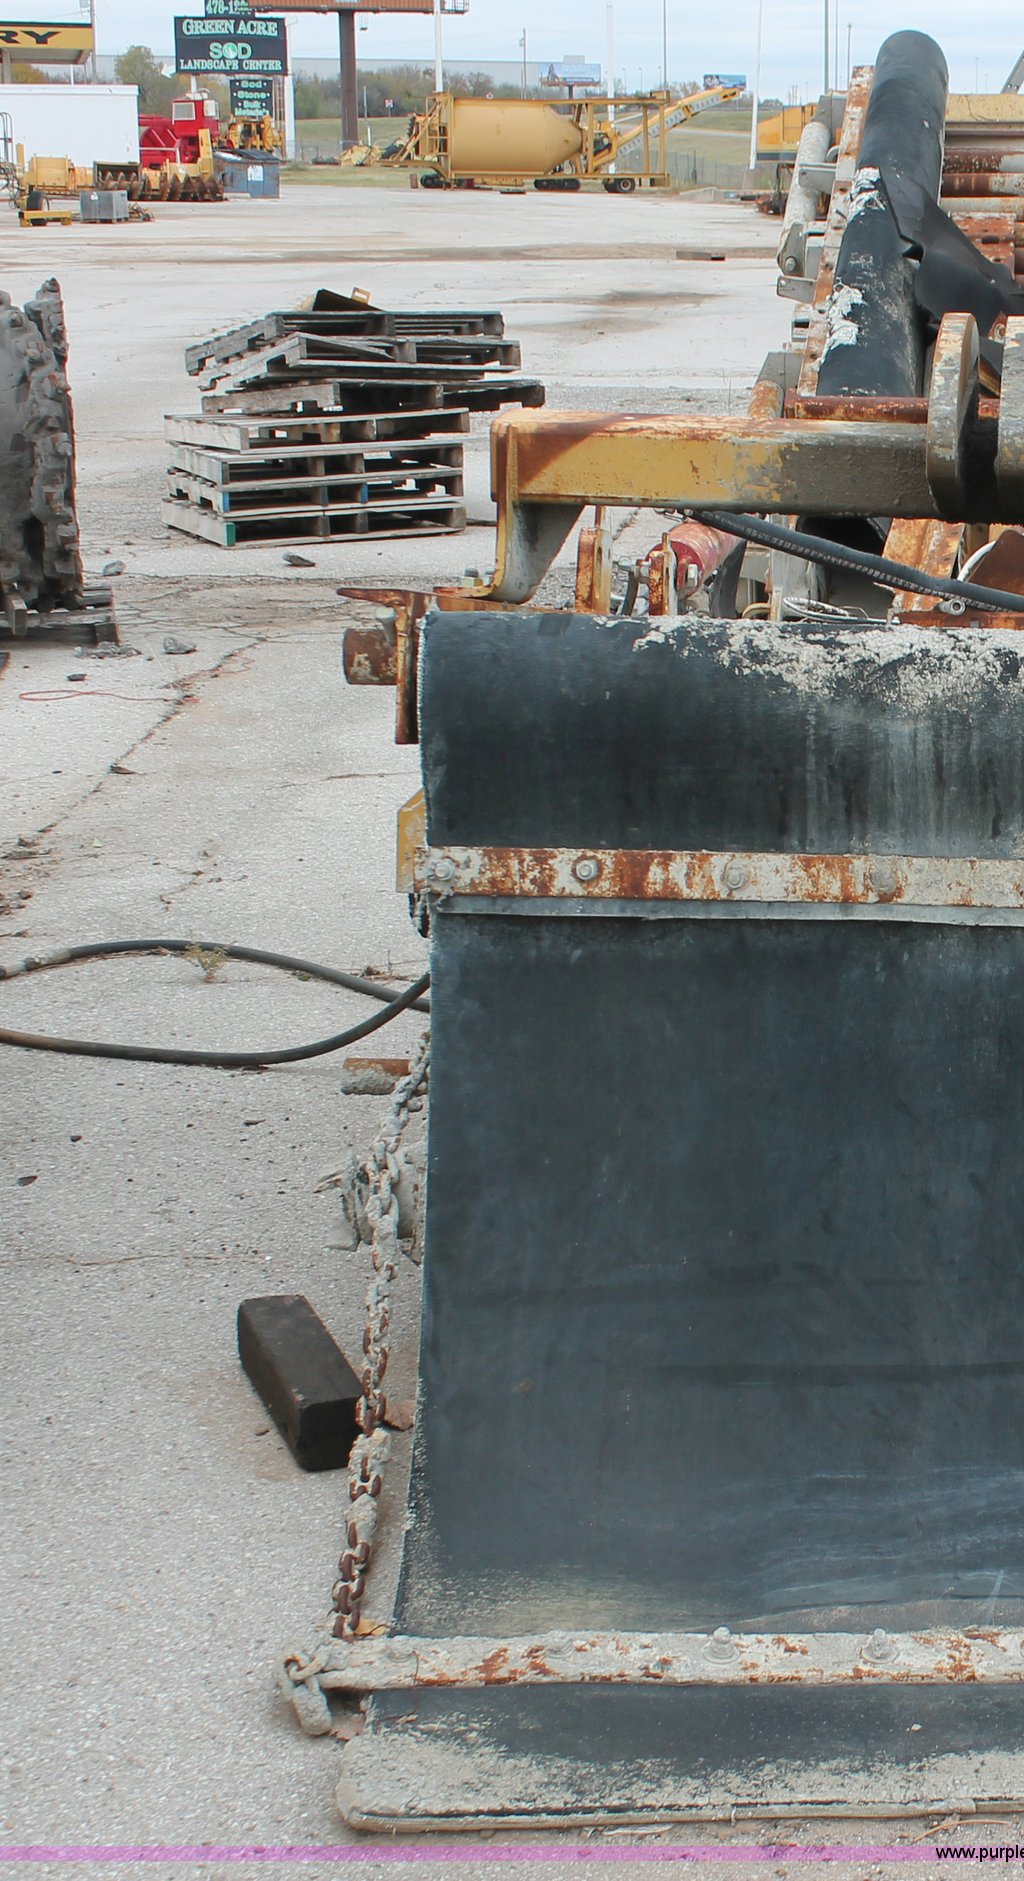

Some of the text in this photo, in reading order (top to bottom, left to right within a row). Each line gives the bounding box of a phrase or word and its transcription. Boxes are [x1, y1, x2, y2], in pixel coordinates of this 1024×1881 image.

[182, 19, 278, 37] GREEN ACRE
[209, 42, 252, 59] SOD
[179, 59, 282, 71] LANDSCAPE CENTER
